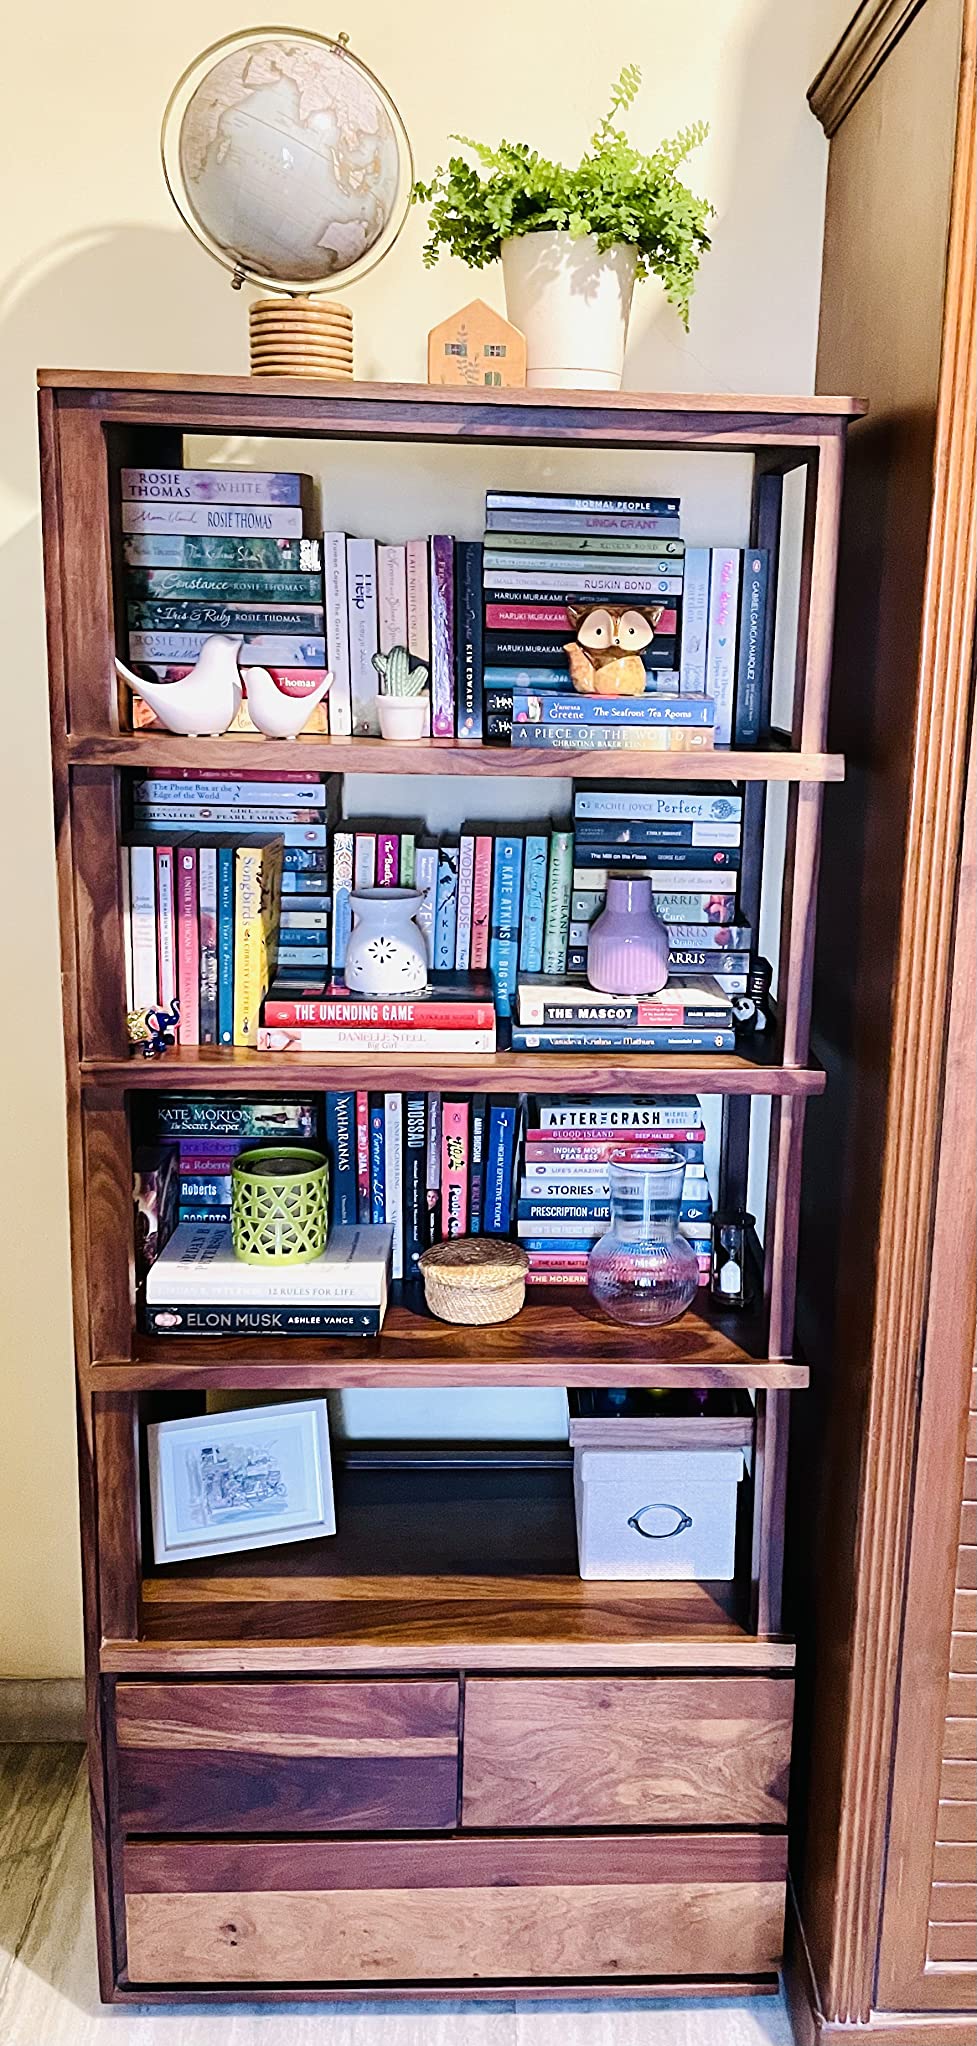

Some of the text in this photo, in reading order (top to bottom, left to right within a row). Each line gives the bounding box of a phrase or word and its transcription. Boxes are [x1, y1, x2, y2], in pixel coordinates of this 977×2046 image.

[140, 473, 180, 485] ROSIE
[128, 482, 262, 498] THOMAS WHITE
[576, 500, 650, 510] NORMAL PEOPLE
[207, 512, 273, 529] ROSIE THOMAS
[586, 519, 617, 528] LINDA
[621, 520, 659, 530] GRANT
[160, 574, 304, 592] Constance ROSIE THOMAS
[584, 579, 620, 590] RUSKIN
[624, 581, 652, 591] BOND
[352, 574, 372, 610] Help
[494, 592, 562, 602] HARUKI MURAKAMI
[751, 581, 760, 612] GABRIEL
[163, 608, 300, 626] Iris & Ruby ROSIE THOMAS
[410, 615, 417, 630] ON
[499, 612, 566, 622] HARUKI MURAKAMI
[134, 636, 175, 646] ROSIE
[497, 644, 524, 652] HARUKI
[278, 677, 316, 688] Thomas
[550, 707, 692, 719] Greene The Seafront Tea Rooms
[553, 703, 581, 711] Vanessa
[520, 728, 629, 739] A PIECE OF THE
[552, 740, 622, 748] CHRISTINA BAKER
[153, 783, 168, 791] The
[170, 784, 193, 792] Phone
[195, 784, 210, 792] Box
[153, 792, 172, 800] Edge
[198, 792, 220, 800] World
[594, 802, 626, 810] RACHEL
[656, 800, 704, 816] Perfect
[184, 876, 192, 902] UNDER
[240, 856, 255, 926] Songbirds
[459, 842, 472, 928] WODEHOUSE
[222, 886, 230, 908] Mayle
[548, 858, 559, 935] DURGAWATI
[184, 904, 192, 918] THE
[560, 905, 568, 935] RANI
[184, 920, 192, 947] TUSCAN
[497, 866, 513, 1000] KATE ATKINSON BIG SKY
[668, 928, 708, 937] ARRIS
[668, 952, 706, 964] ARRIS
[294, 1004, 414, 1022] THE UNENDING GAME
[548, 1008, 572, 1018] THE
[578, 1008, 633, 1019] MASCOT
[185, 1010, 193, 1038] MAYES
[338, 1032, 426, 1042] DANIELLE STEEL
[368, 1040, 397, 1050] Big Girl
[158, 1109, 251, 1124] KATE MORTON
[550, 1112, 660, 1126] AFTER CRASH
[170, 1122, 240, 1134] The Secret Keeper
[407, 1100, 424, 1148] MOSSAD
[334, 1096, 350, 1172] MAHARANAS
[552, 1130, 581, 1138] BLOOD
[200, 1140, 240, 1152] Roberts
[473, 1118, 482, 1163] AMAR BHUSHAN
[194, 1160, 230, 1170] Roberts
[494, 1119, 507, 1228] 7 HIGHLY EFFECTIVE PEOPLE
[182, 1184, 217, 1196] Roberts
[374, 1178, 383, 1206] LIE
[548, 1186, 594, 1194] STORIES
[450, 1187, 462, 1218] Paulo
[530, 1206, 610, 1217] PRESCRIPTION LIFE
[268, 1288, 355, 1297] 12 RULES FOR LIFE
[186, 1314, 354, 1327] ELON MUSK ASHLEE VANCE
